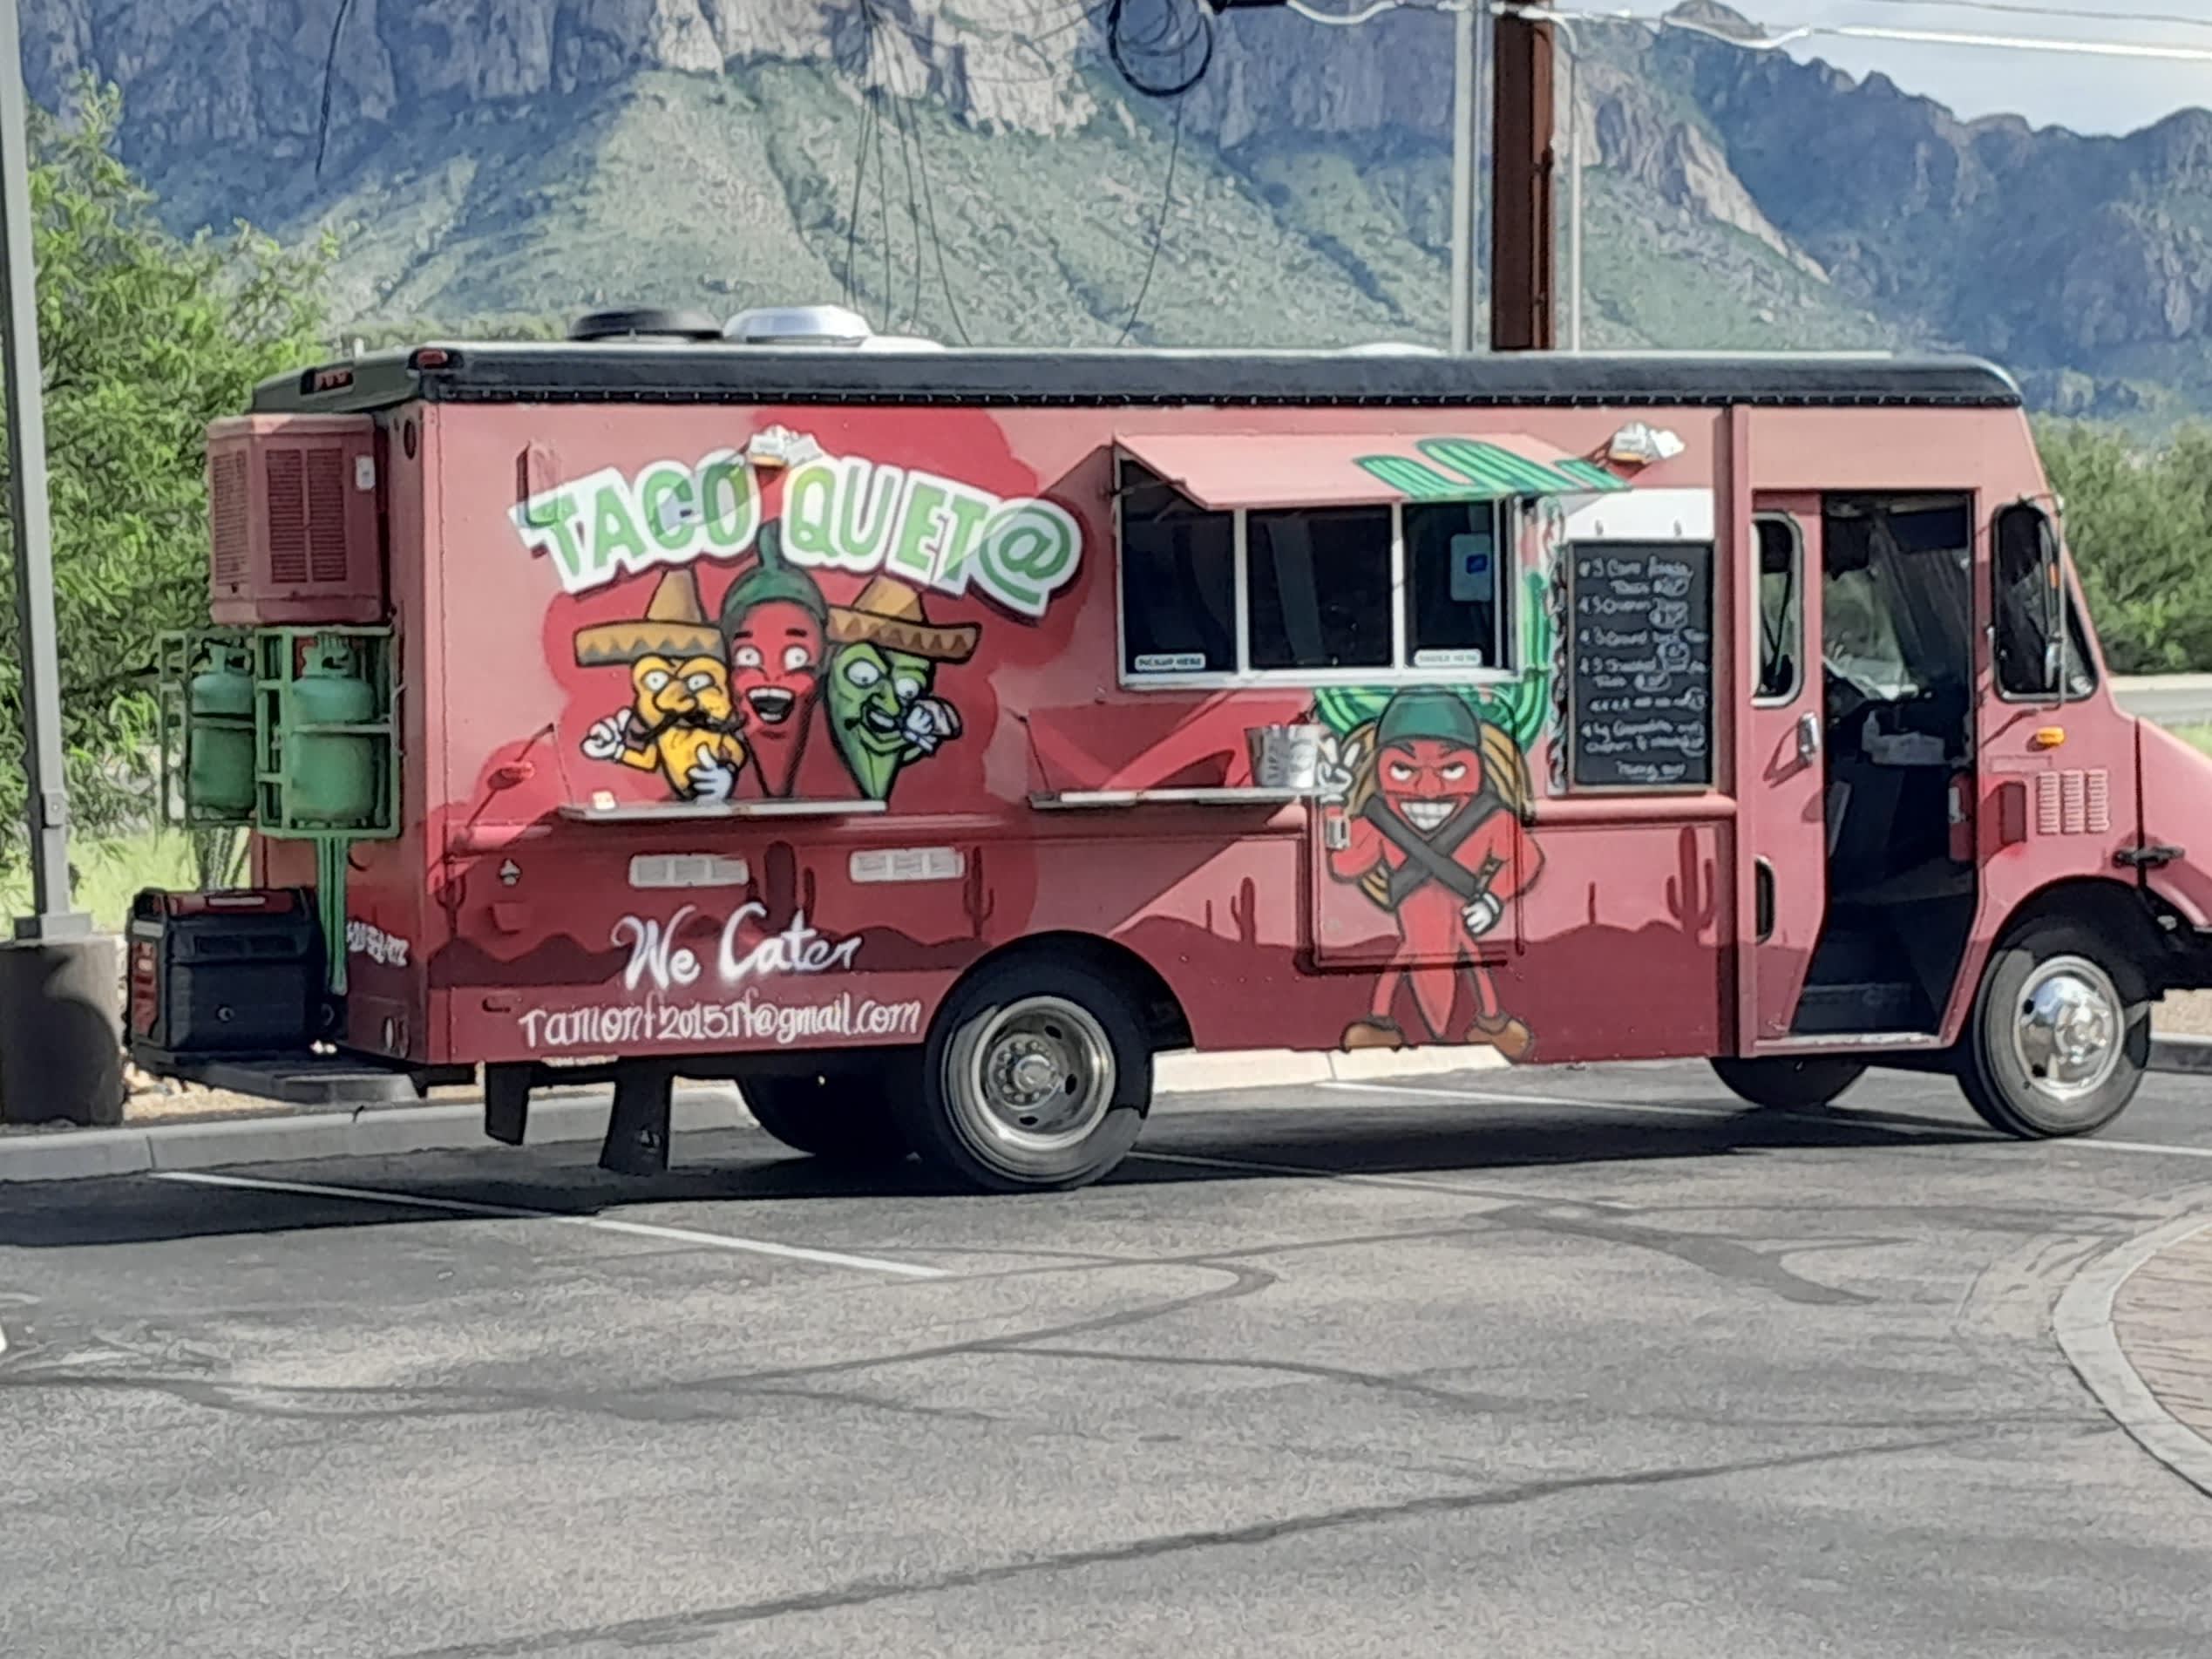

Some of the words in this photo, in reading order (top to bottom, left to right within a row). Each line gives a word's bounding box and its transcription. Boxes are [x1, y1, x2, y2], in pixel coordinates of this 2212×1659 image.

[512, 452, 759, 591] TACO
[782, 459, 1081, 612] QUET@
[610, 904, 701, 990] We
[717, 901, 863, 982] Cater
